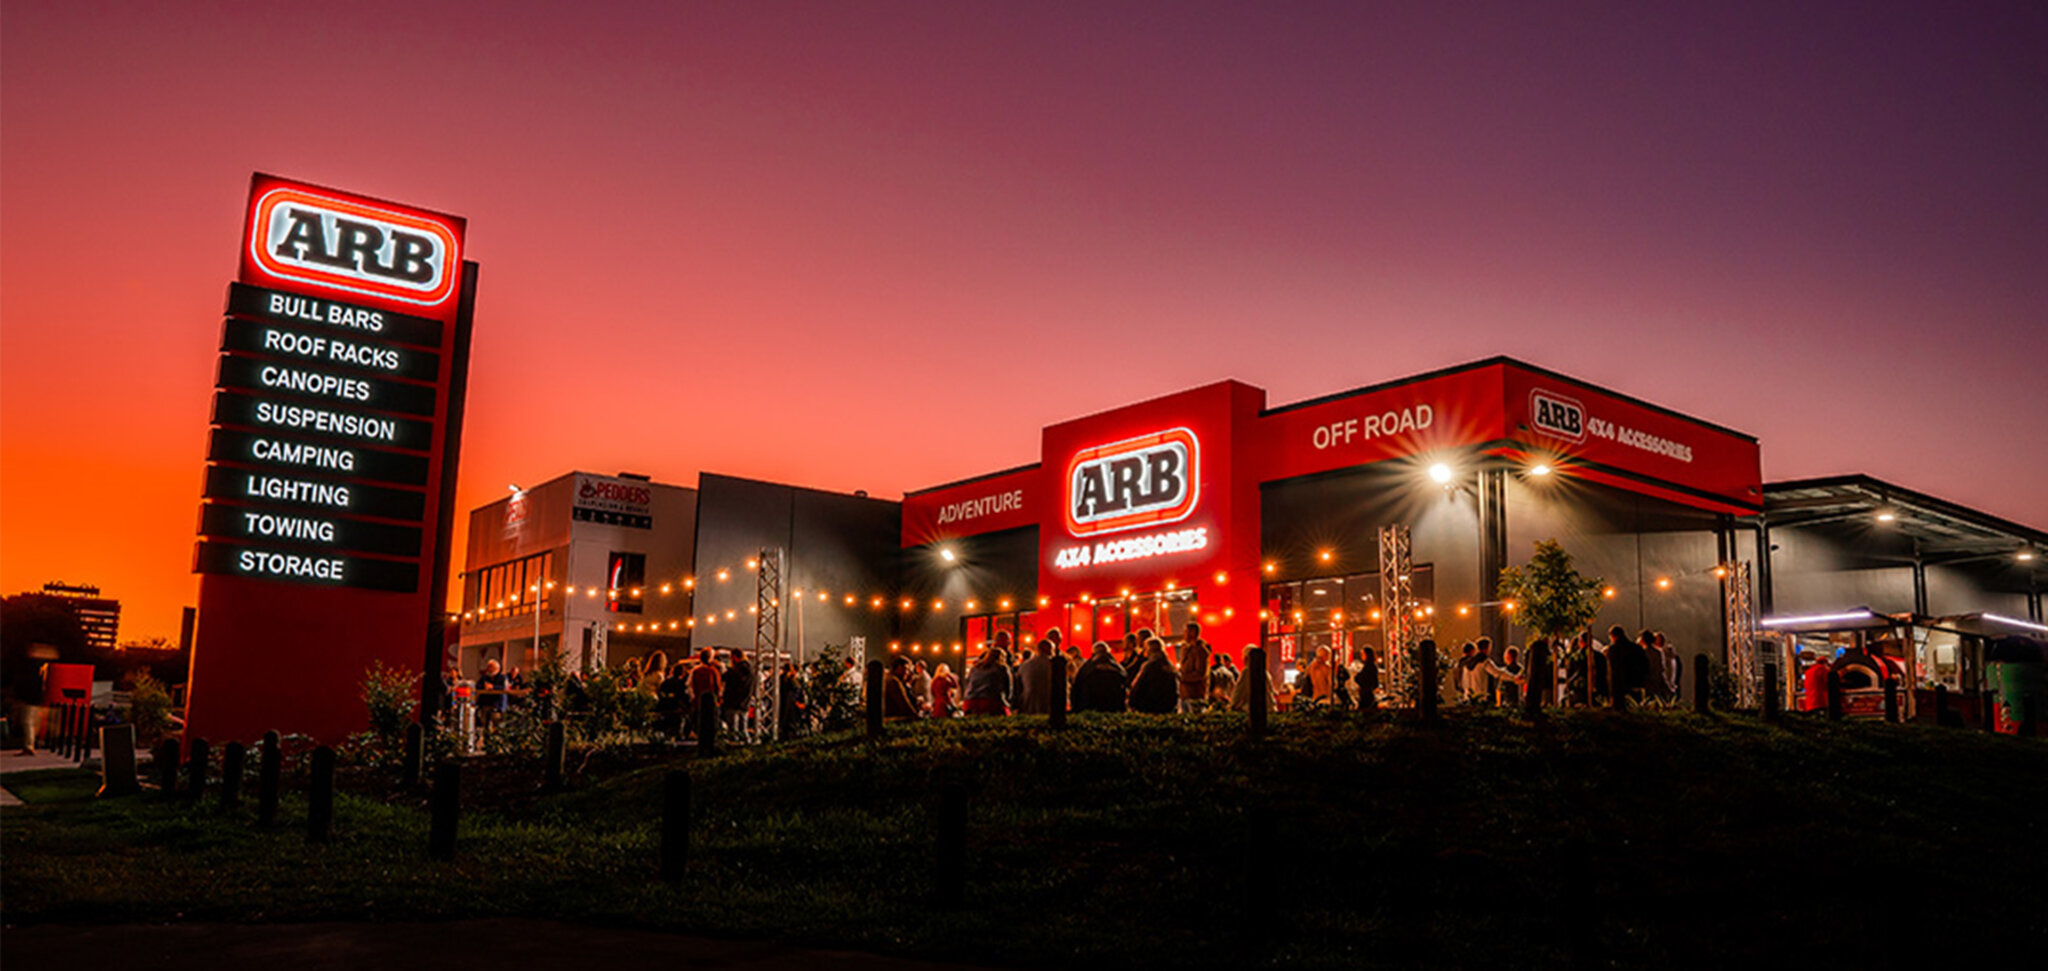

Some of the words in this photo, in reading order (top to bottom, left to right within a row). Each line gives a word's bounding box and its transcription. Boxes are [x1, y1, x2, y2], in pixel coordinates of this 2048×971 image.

[276, 208, 434, 284] ARB
[270, 294, 322, 321] BULL
[329, 305, 383, 331] BARS
[265, 331, 325, 357] ROOF
[330, 343, 399, 369] RACKS
[261, 366, 370, 400] CANOPIES
[257, 403, 395, 441] SUSPENSION
[1313, 419, 1358, 449] OFF
[1365, 404, 1433, 440] ROAD
[1537, 398, 1581, 434] ARB
[1587, 417, 1614, 440] 4X4
[1617, 426, 1692, 463] ACCESSORIES
[252, 439, 354, 471] CAMPING
[247, 476, 350, 506] LIGHTING
[597, 482, 650, 504] PEDDERS
[1076, 448, 1181, 519] ARB
[938, 490, 1023, 524] ADVENTURE
[244, 513, 335, 542] TOWING
[240, 551, 344, 580] STORAGE
[1055, 546, 1091, 569] 4X4
[1093, 528, 1207, 564] ACCESSORIES
